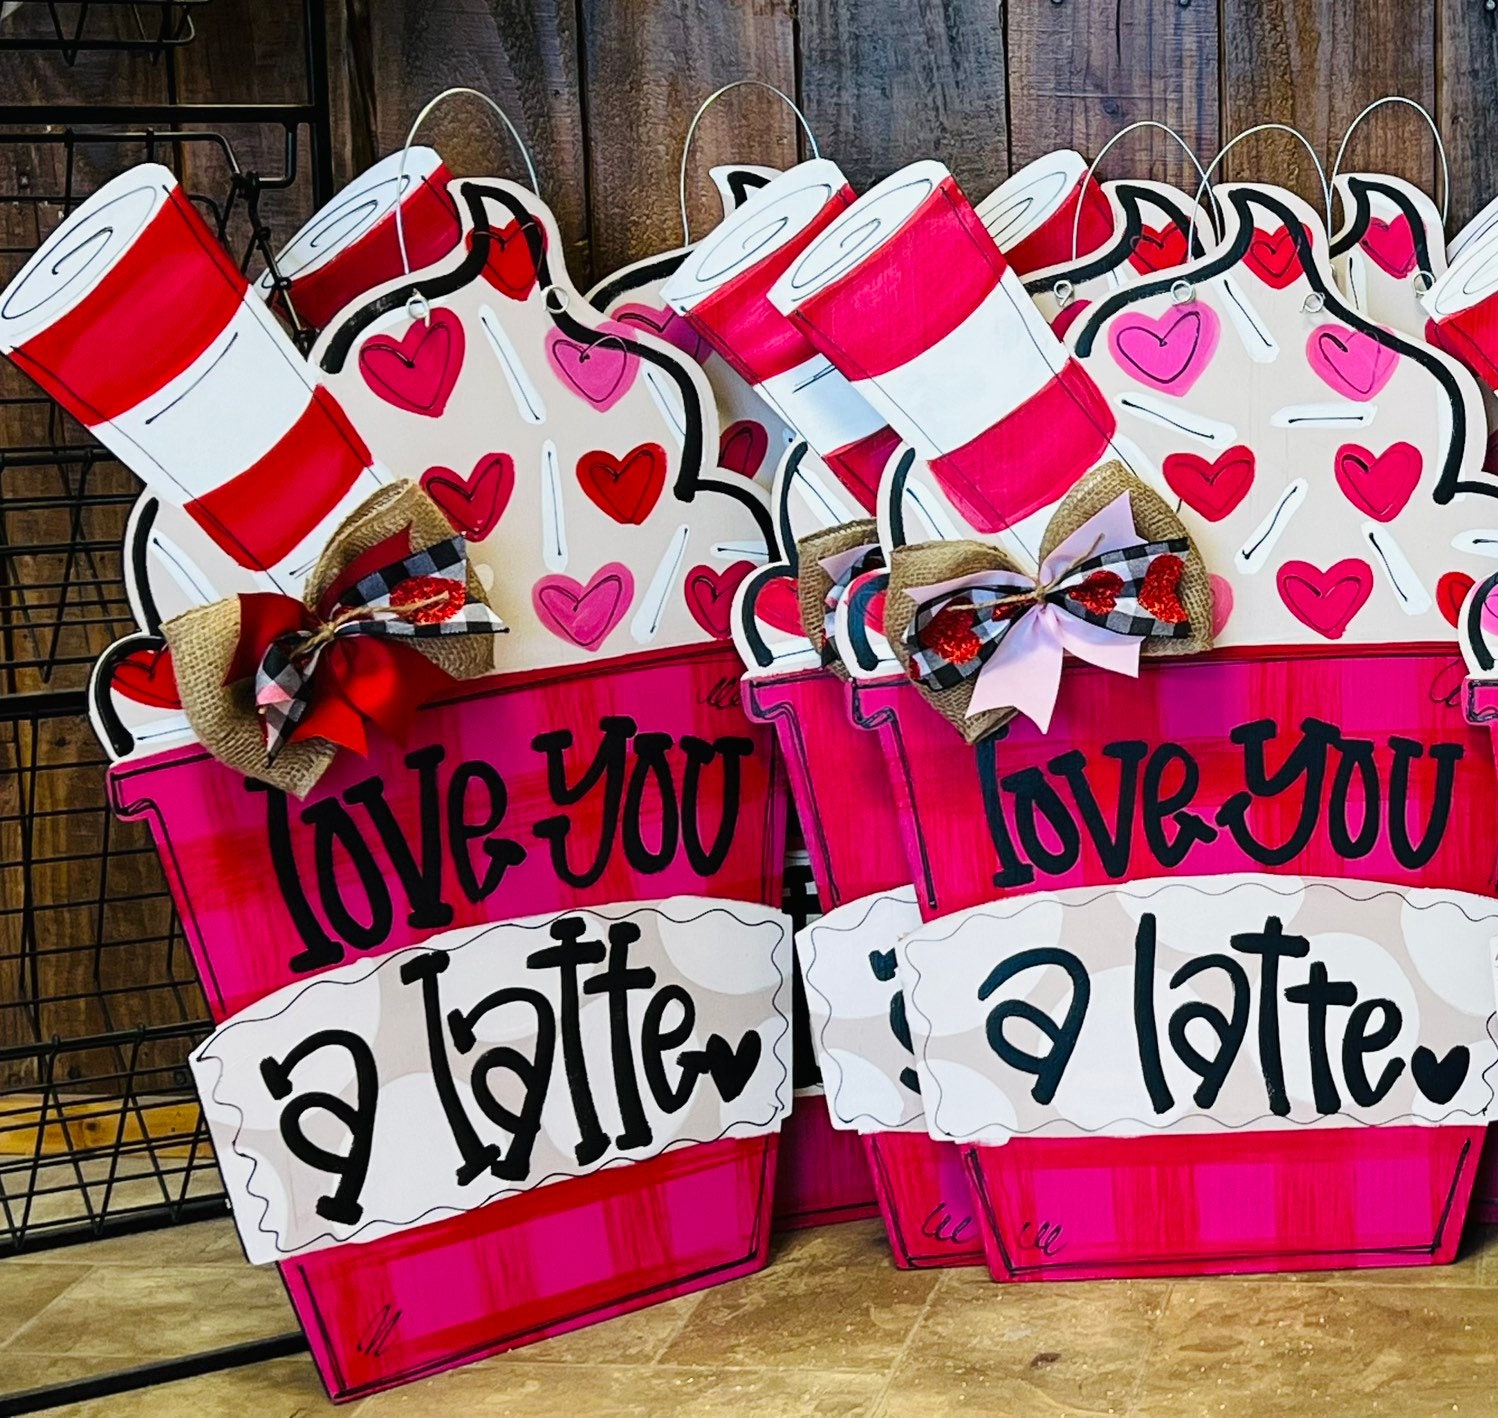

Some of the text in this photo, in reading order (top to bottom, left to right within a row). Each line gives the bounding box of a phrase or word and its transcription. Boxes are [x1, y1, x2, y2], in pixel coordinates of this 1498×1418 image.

[245, 716, 755, 972] love you
[975, 717, 1465, 888] love you
[260, 1029, 378, 1225] a
[400, 917, 704, 1186] latte
[977, 947, 1091, 1105] a
[1134, 912, 1406, 1116] latte
